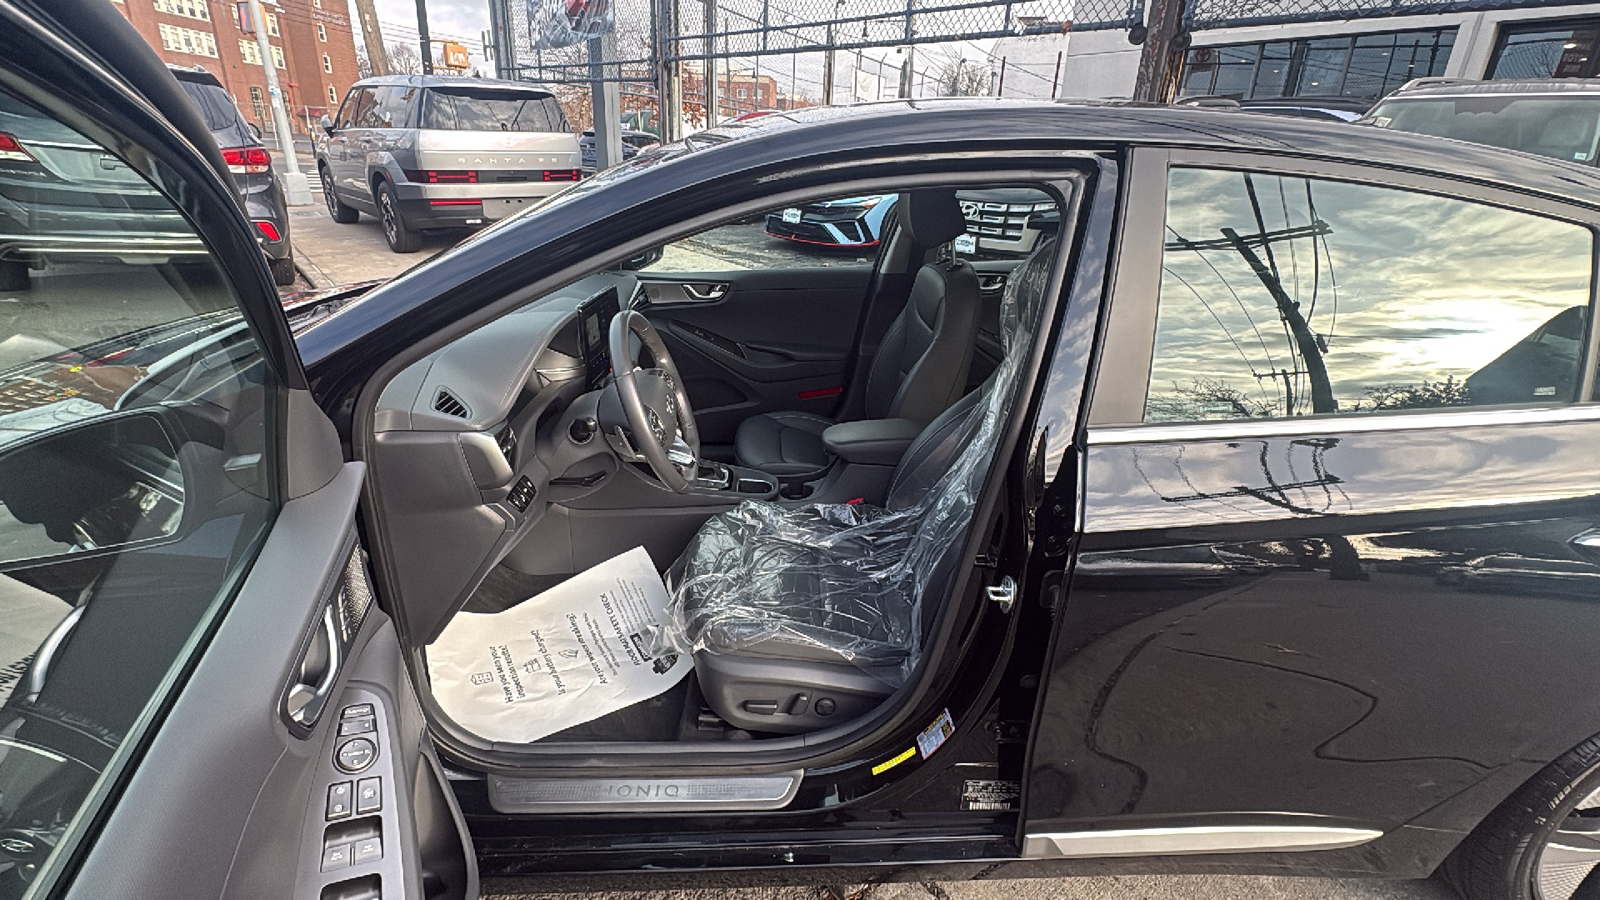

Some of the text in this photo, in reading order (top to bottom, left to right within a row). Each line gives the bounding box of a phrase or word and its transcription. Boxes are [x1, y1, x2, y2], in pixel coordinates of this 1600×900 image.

[600, 593, 614, 615] CHECK
[566, 613, 585, 645] streaking?
[610, 615, 624, 639] SAFETY
[582, 644, 595, 662] wipers
[620, 638, 631, 650] MAT
[531, 629, 566, 696] Is your battery charged?
[592, 661, 604, 673] your
[626, 649, 641, 666] FLOOR
[489, 646, 514, 703] Have you seen your
[509, 666, 526, 699] inspection
[598, 673, 608, 684] Are
[608, 784, 679, 798] IONIQ
